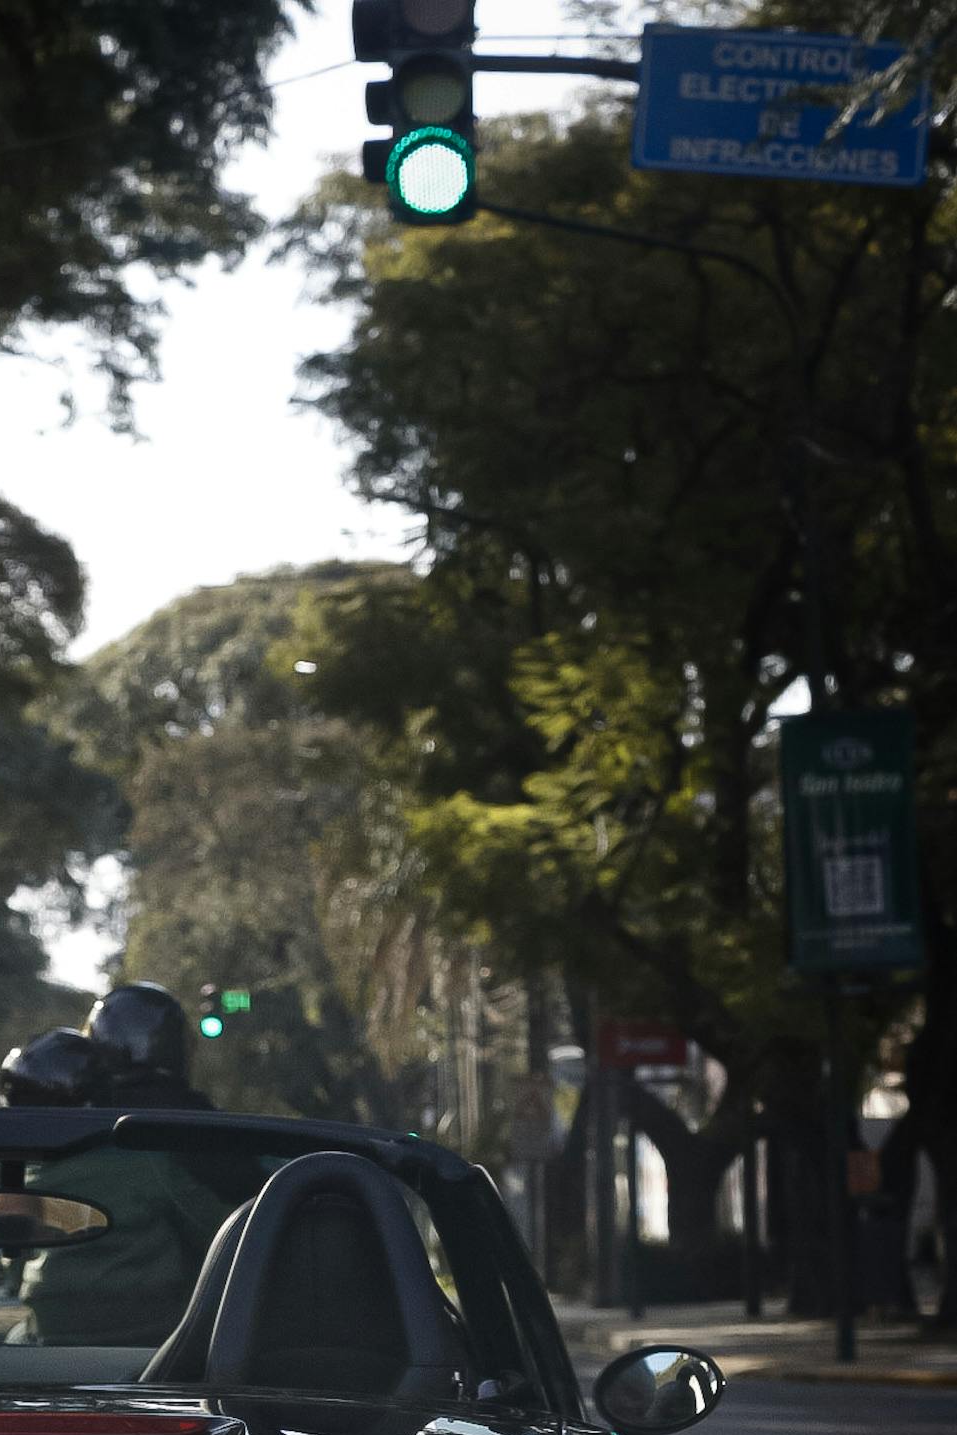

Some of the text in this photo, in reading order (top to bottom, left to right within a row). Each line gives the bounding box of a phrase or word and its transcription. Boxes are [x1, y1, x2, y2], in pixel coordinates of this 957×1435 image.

[715, 41, 864, 77] CONTROL
[758, 109, 801, 139] DE
[669, 136, 901, 177] INFRACCIONES
